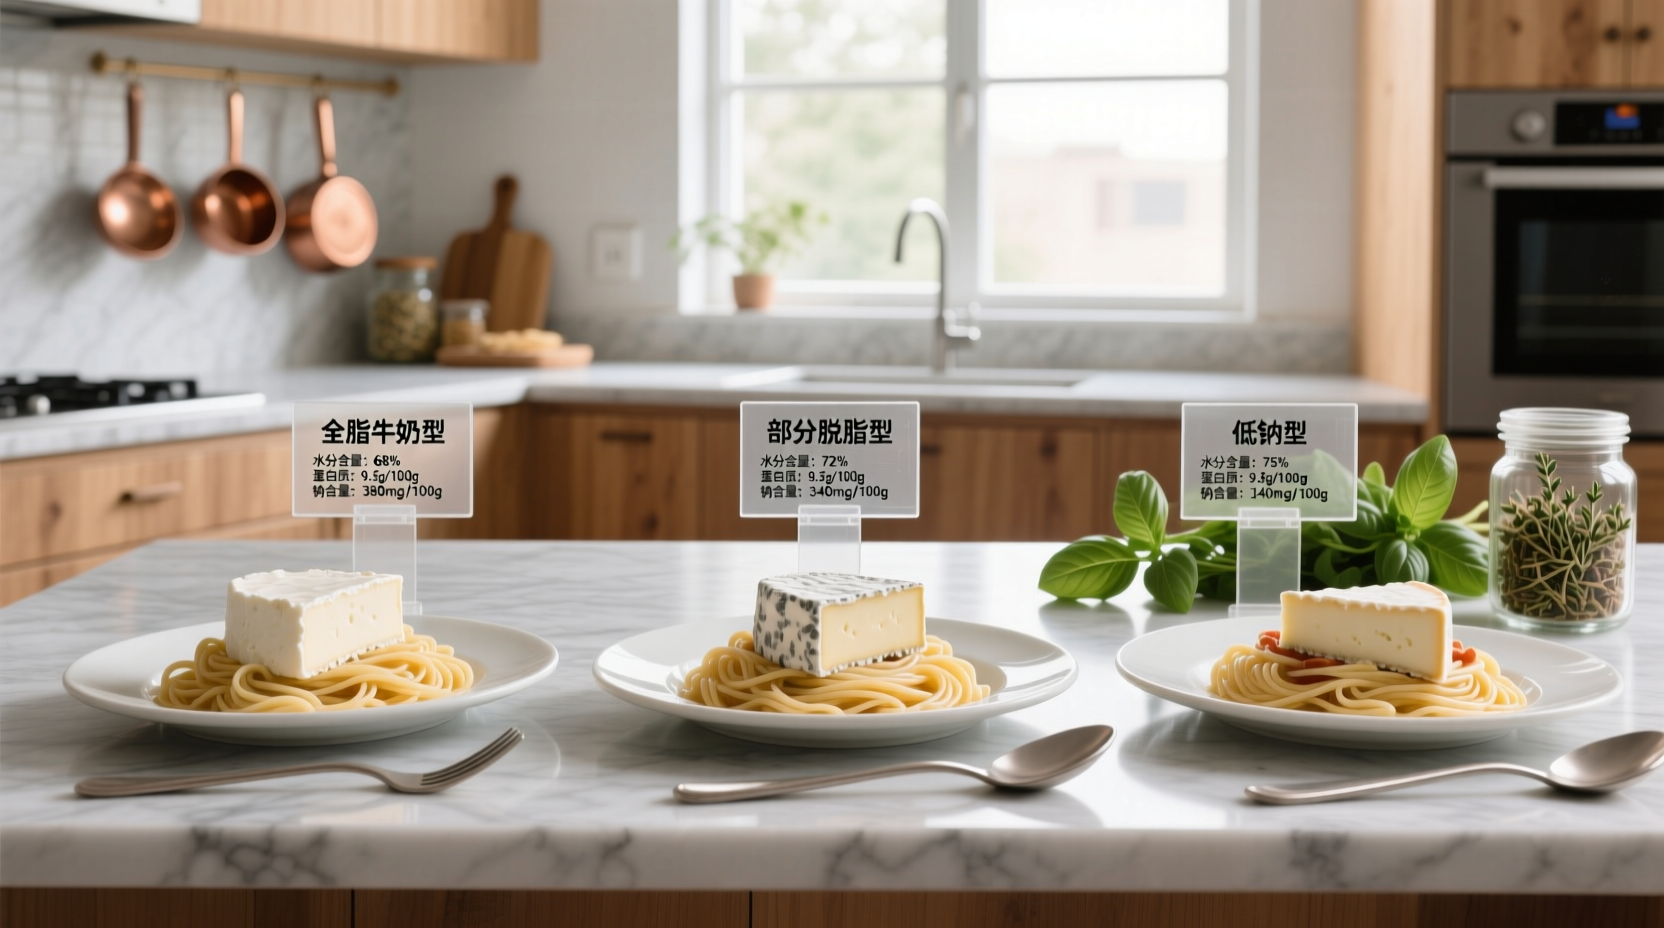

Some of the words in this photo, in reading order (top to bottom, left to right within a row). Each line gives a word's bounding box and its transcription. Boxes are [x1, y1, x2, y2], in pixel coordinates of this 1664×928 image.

[321, 418, 446, 445] 全脂牛奶型
[767, 418, 893, 445] 部分脱脂型
[1232, 419, 1307, 446] 低钠型
[373, 454, 401, 467] 68%
[821, 455, 848, 468] 72%
[1262, 456, 1289, 469] 75%
[362, 484, 443, 500] 380mg/100g
[809, 485, 889, 501] 340mg/100g
